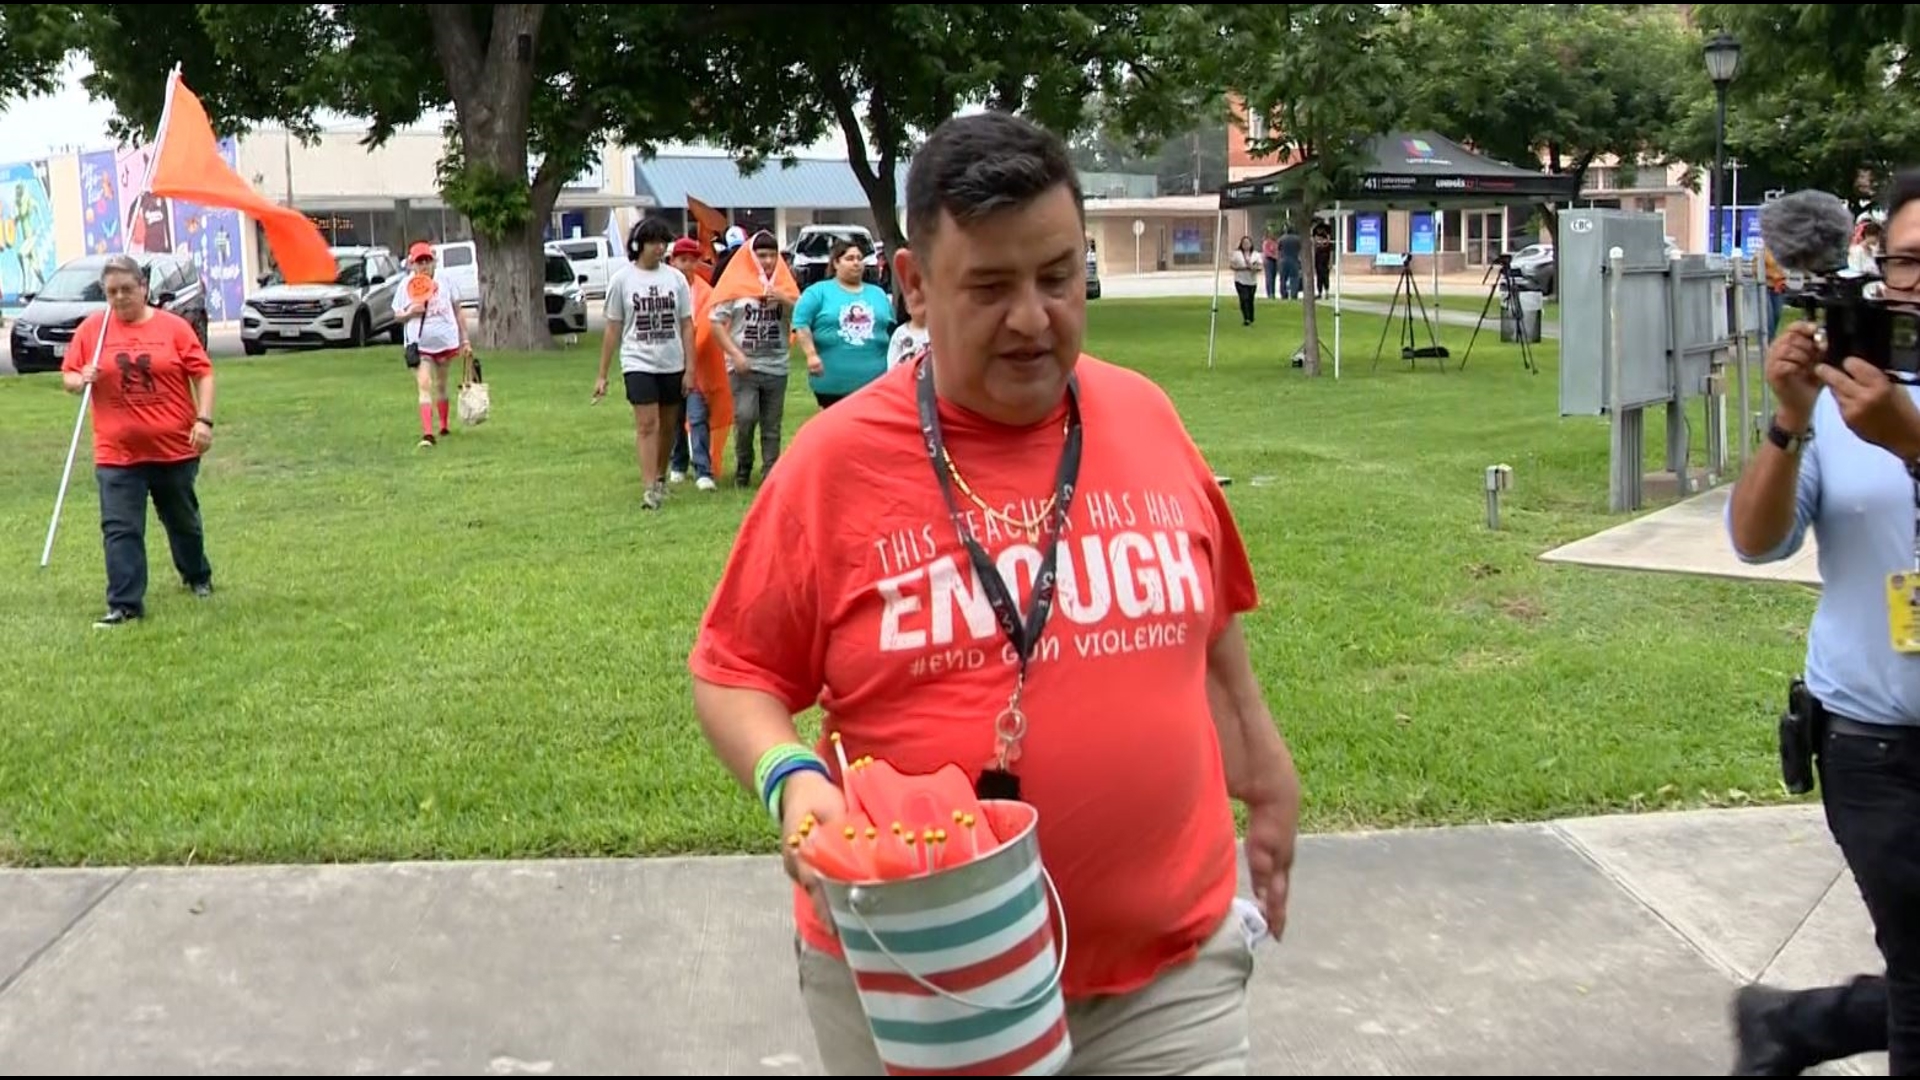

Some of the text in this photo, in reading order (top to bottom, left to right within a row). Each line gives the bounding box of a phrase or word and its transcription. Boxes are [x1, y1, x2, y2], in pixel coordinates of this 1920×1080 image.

[874, 525, 937, 574] THIS
[1086, 491, 1137, 531] HAS
[1144, 489, 1185, 528] HAD
[876, 530, 1205, 652] ENOUGH
[1074, 622, 1188, 657] VIOLENCE
